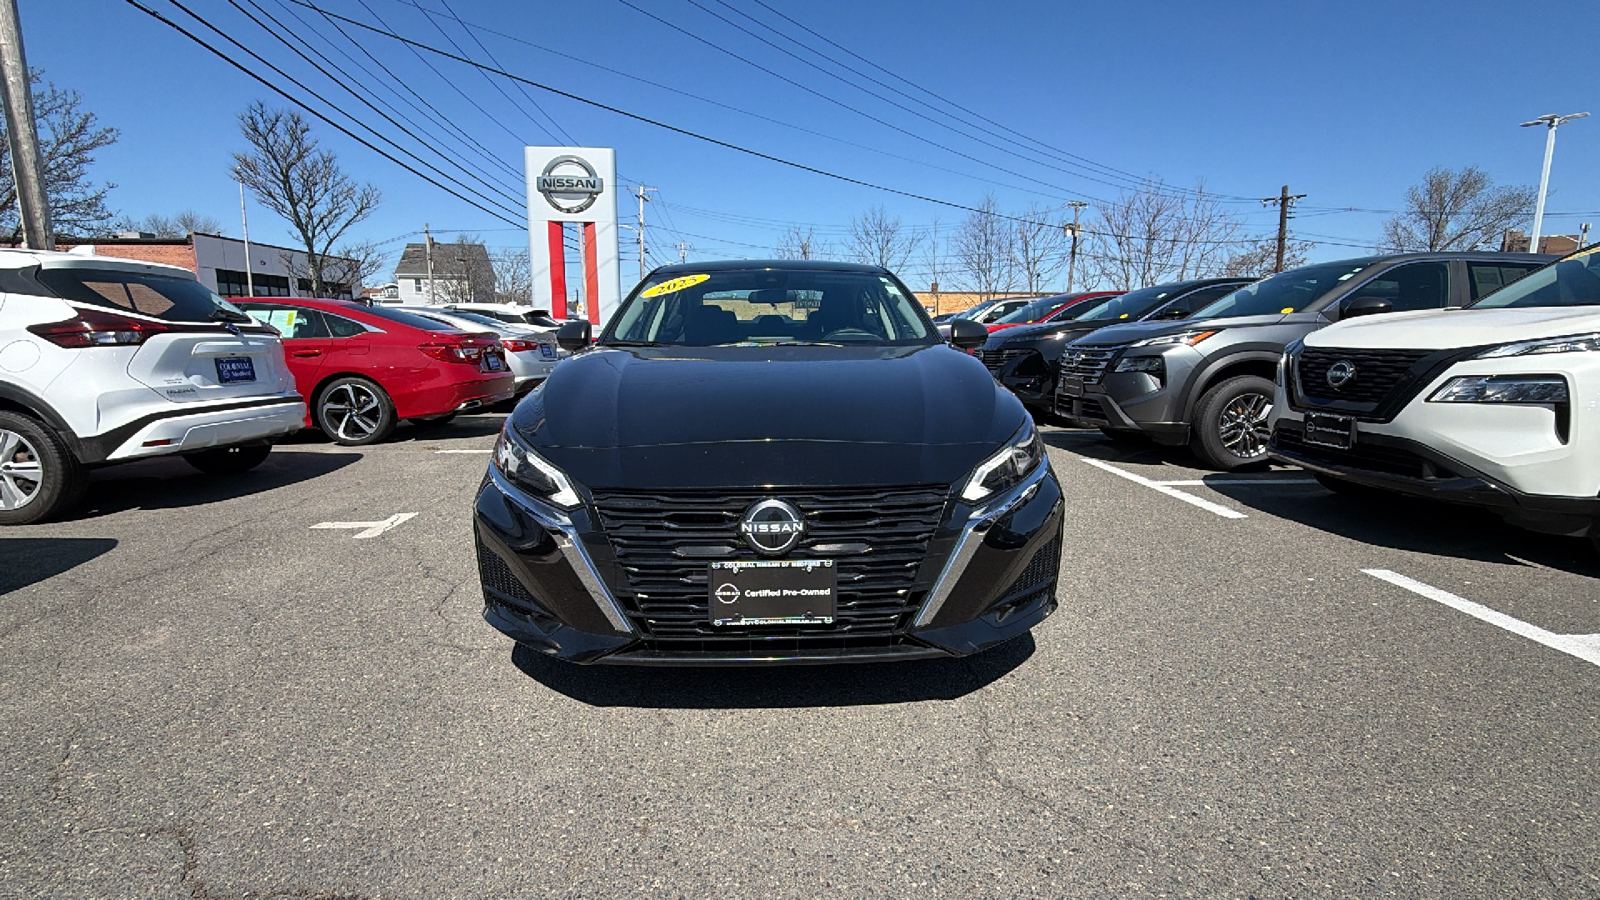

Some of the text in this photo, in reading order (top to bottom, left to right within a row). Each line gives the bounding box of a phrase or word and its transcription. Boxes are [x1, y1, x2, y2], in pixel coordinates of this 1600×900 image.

[542, 178, 597, 189] NISSAN
[657, 276, 697, 294] 2025
[741, 523, 803, 532] NISSAN
[745, 588, 830, 597] Certified Pre-Owned
